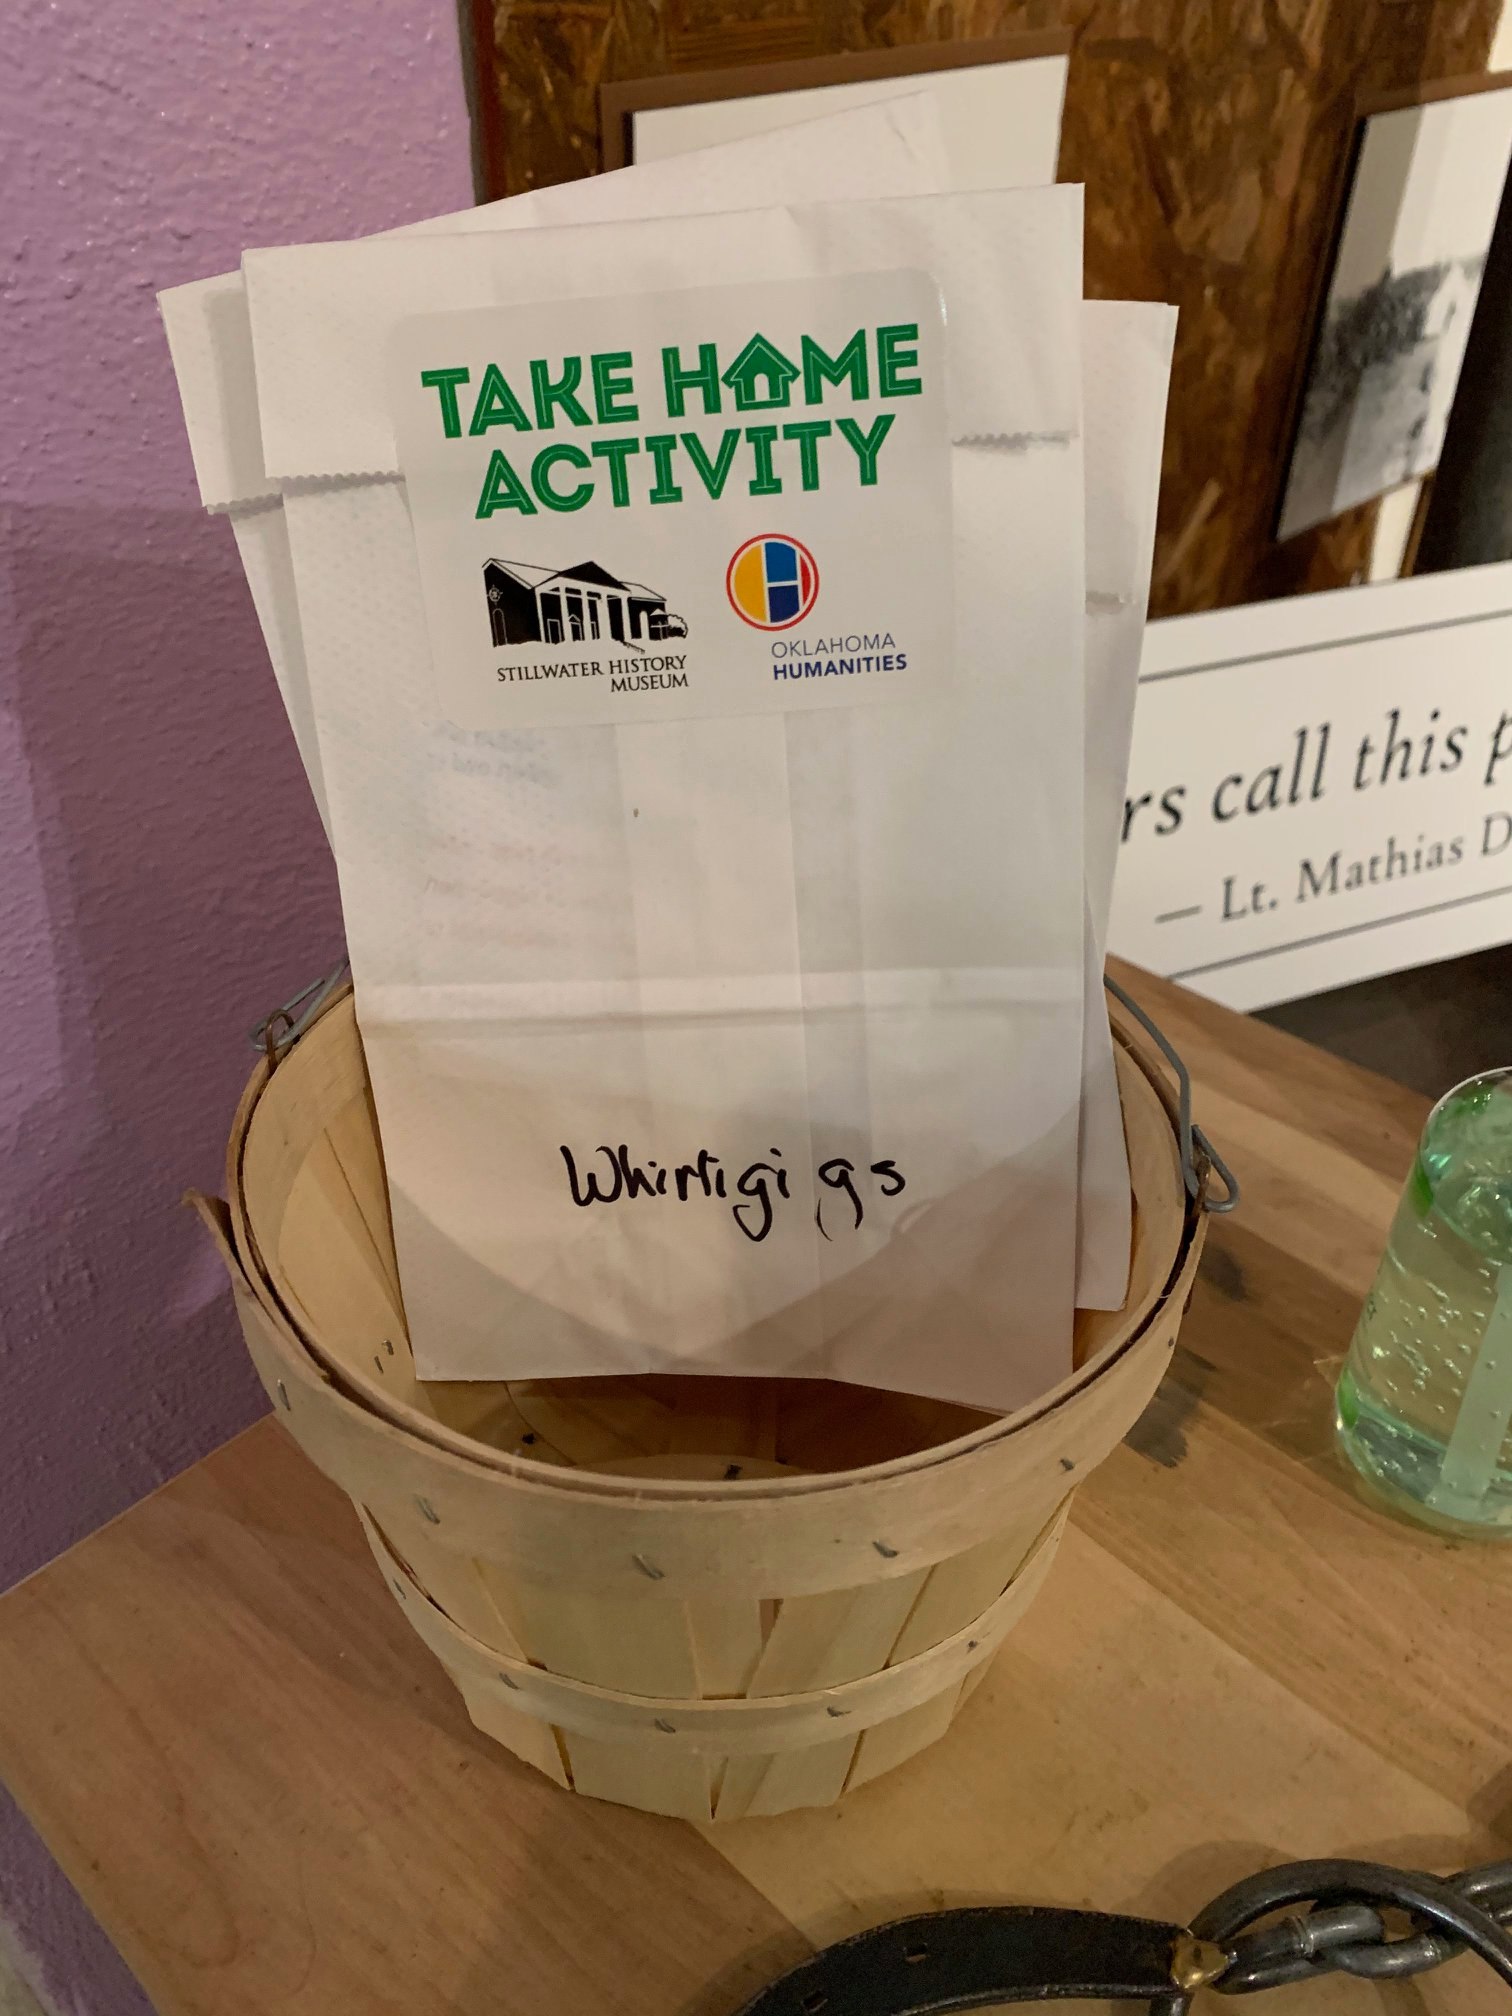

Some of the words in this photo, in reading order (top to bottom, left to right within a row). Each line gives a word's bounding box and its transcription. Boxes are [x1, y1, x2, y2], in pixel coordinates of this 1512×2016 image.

[421, 351, 640, 439] TAKE
[661, 323, 923, 418] HOME
[475, 414, 897, 520] ACTIVITY
[497, 661, 604, 683] STILLWATER
[608, 655, 687, 676] HISTORY
[771, 633, 897, 660] OKLAHOMA
[773, 653, 908, 681] HUMANITIES
[610, 673, 690, 693] MUSEUM
[1211, 722, 1332, 823] call
[1353, 708, 1469, 791] this
[1220, 875, 1280, 922] Lt.
[1295, 835, 1464, 905] Mathias
